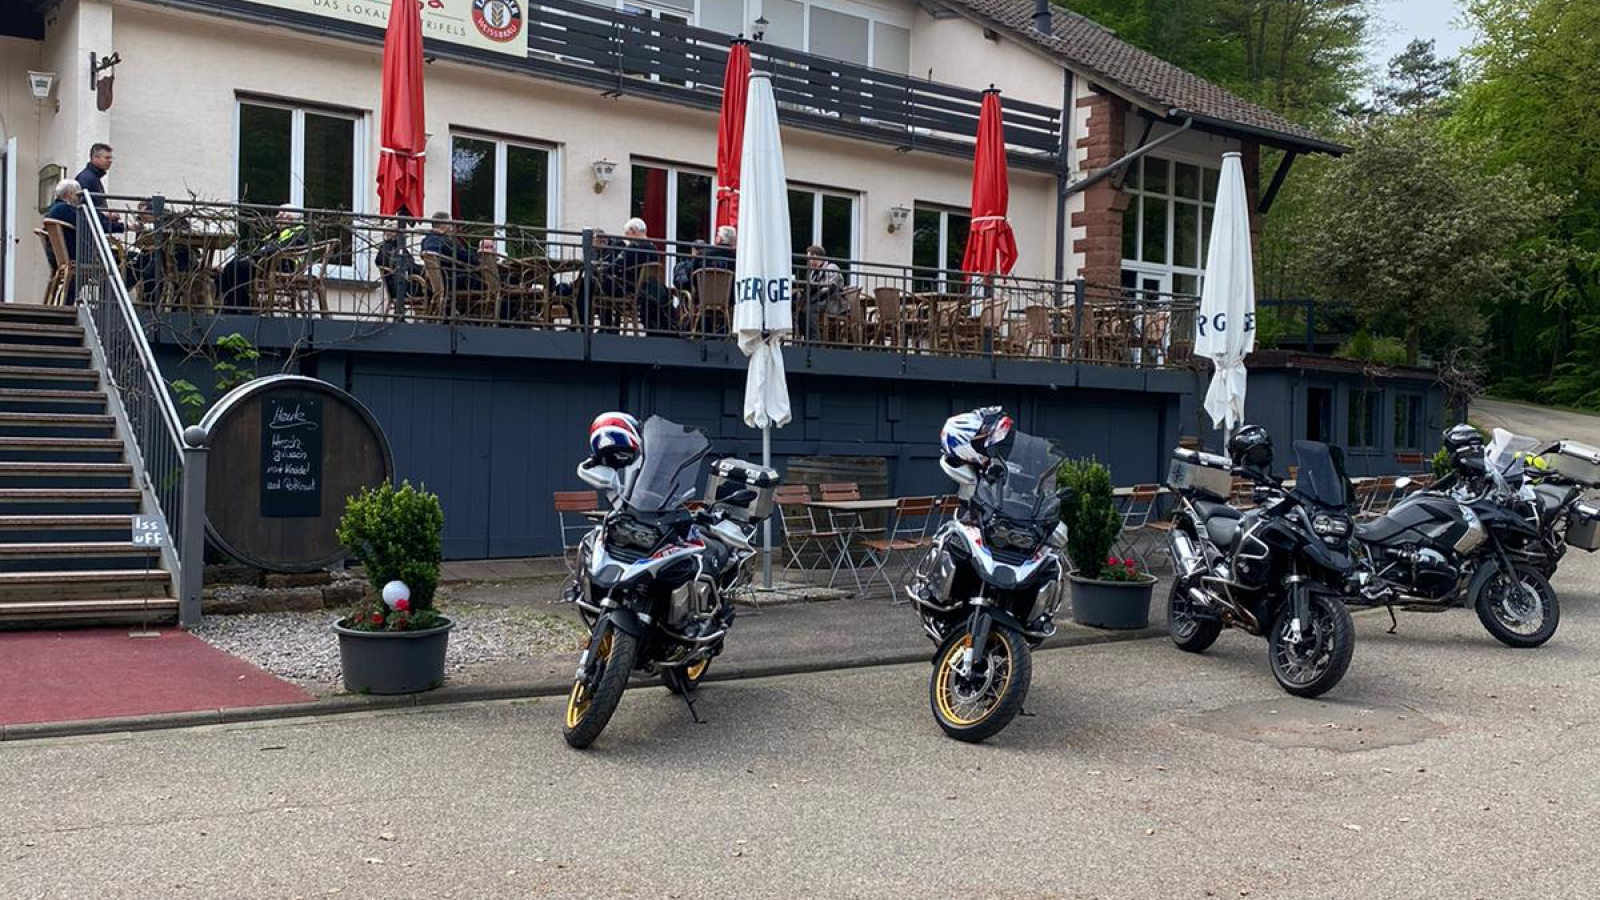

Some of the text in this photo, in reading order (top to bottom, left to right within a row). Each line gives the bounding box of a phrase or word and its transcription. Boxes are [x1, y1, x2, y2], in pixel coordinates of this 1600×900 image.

[313, 0, 466, 36] DAS LOKAL RIFELS
